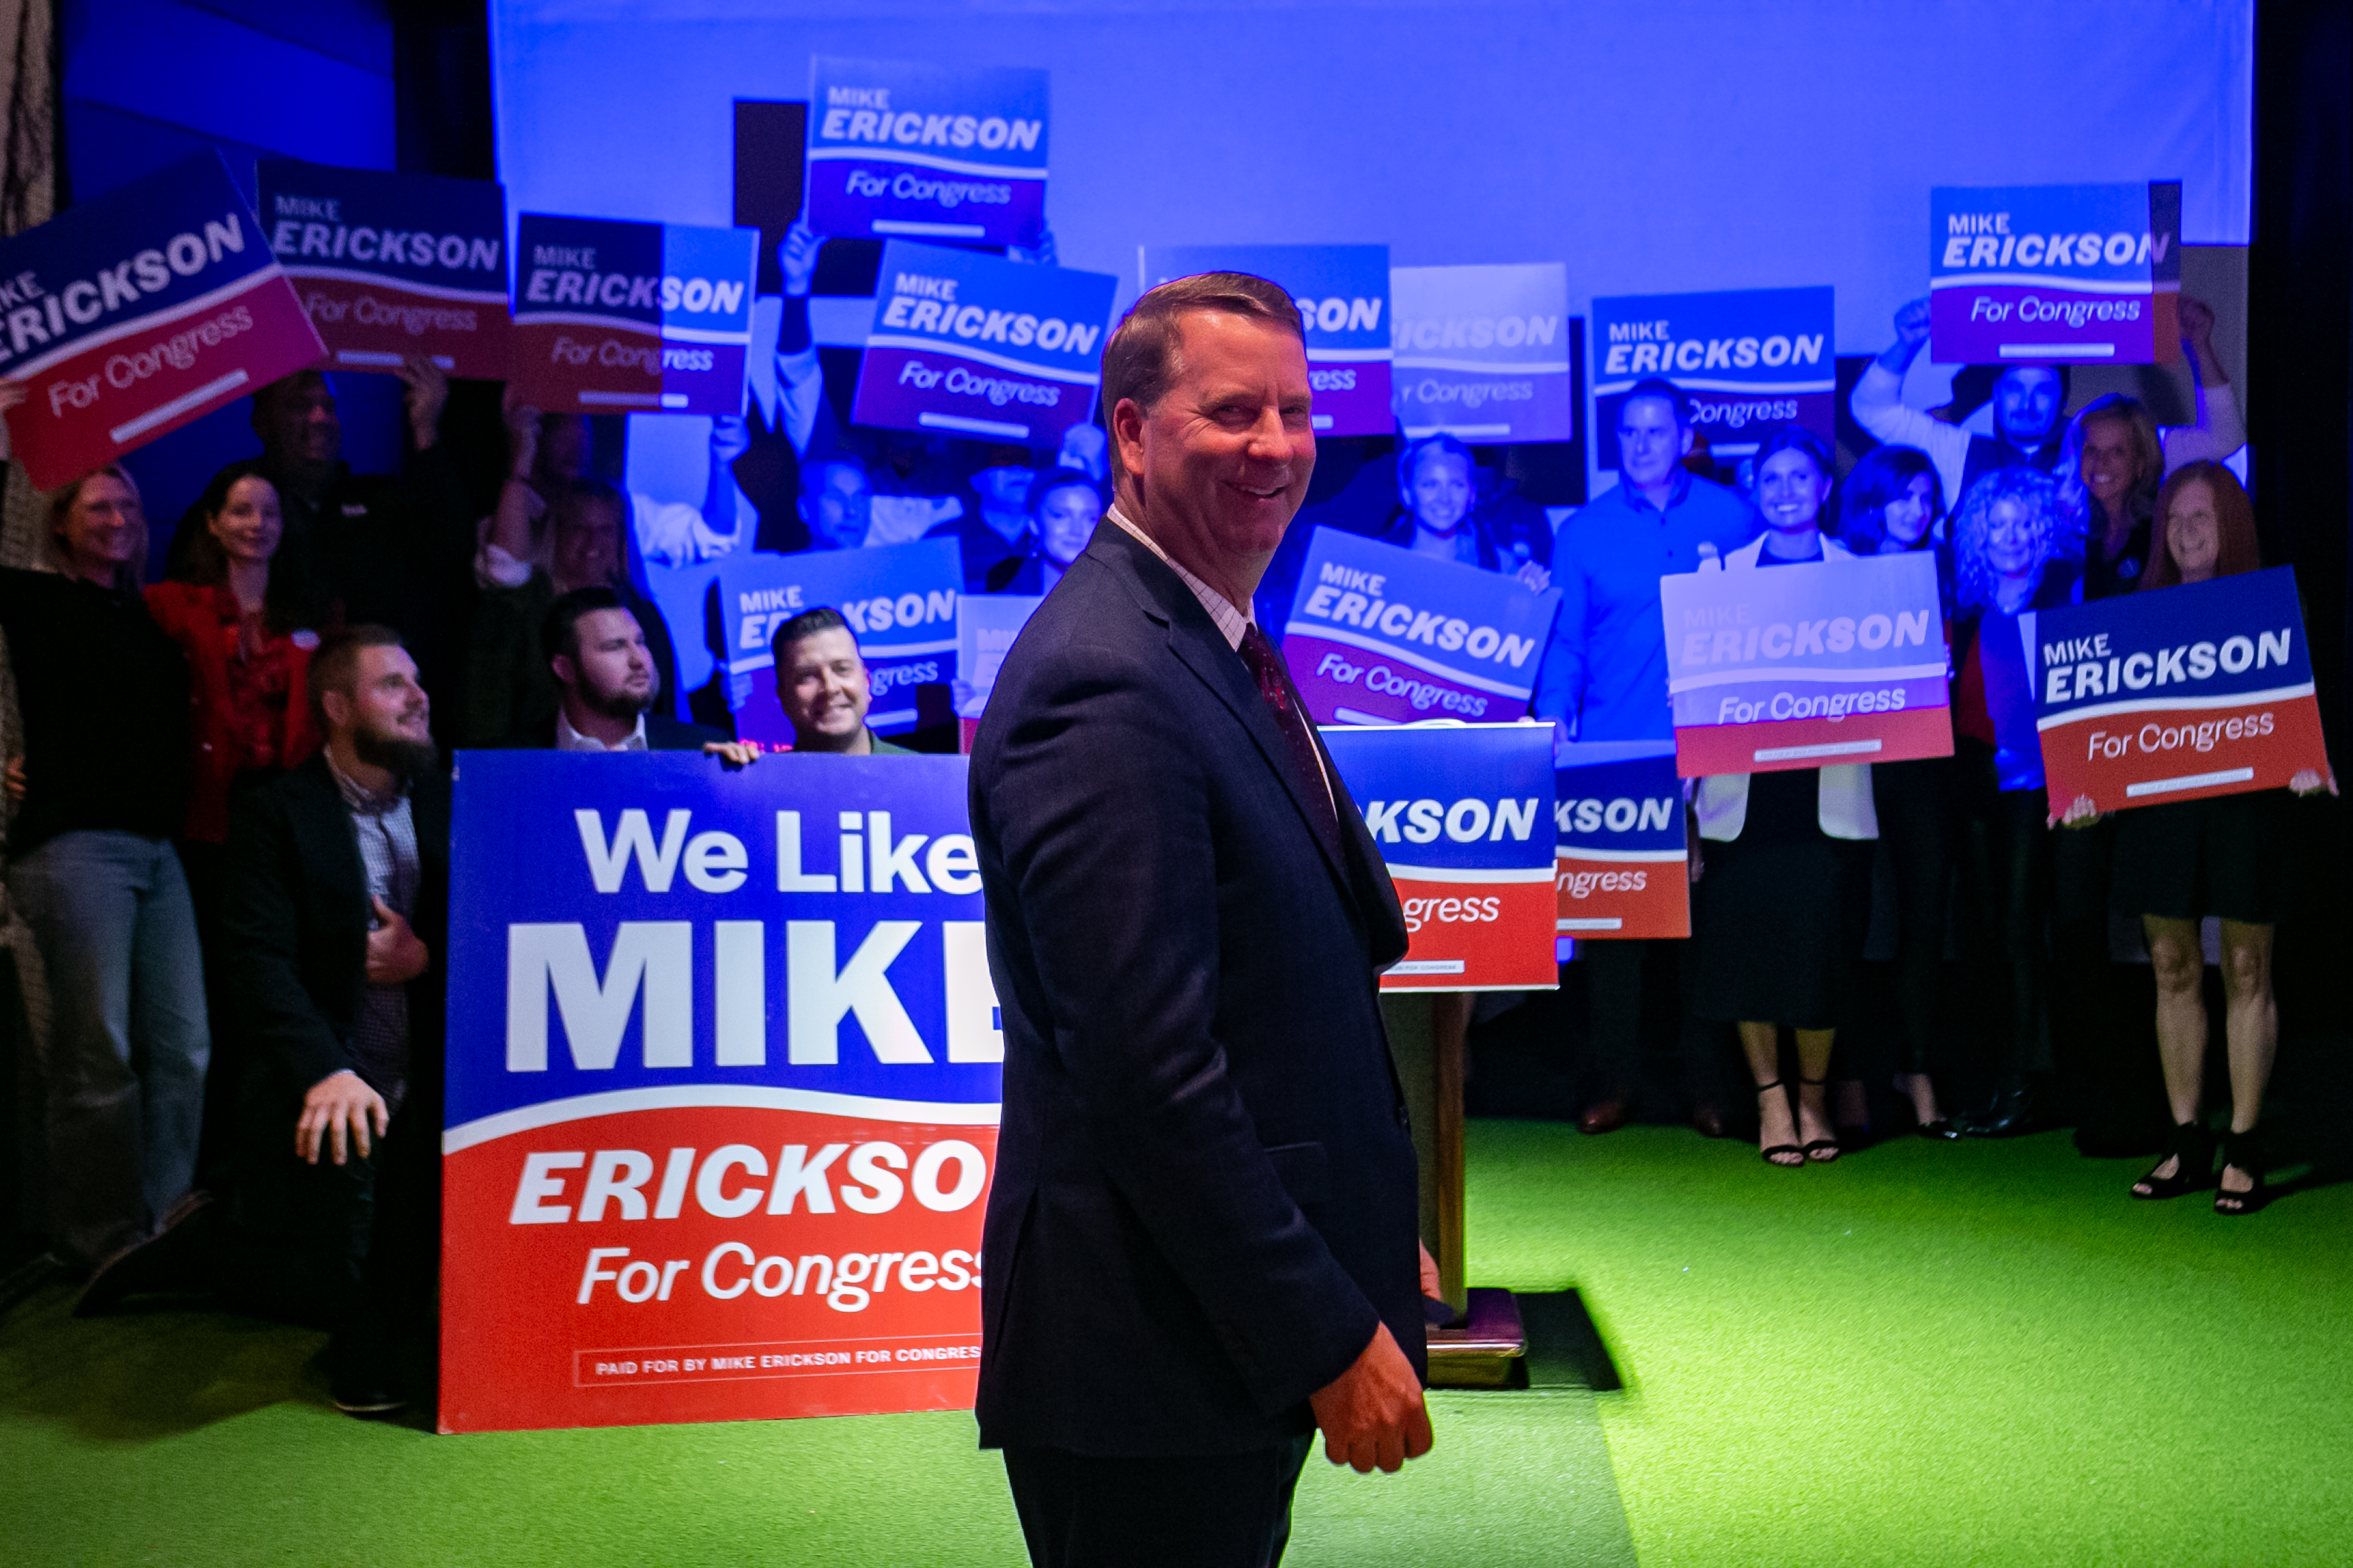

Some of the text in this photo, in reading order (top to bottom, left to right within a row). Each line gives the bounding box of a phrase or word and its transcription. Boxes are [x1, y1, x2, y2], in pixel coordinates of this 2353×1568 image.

[828, 86, 890, 110] MIKE
[821, 108, 1041, 151] ERICKSON
[274, 195, 340, 221] MIKE
[846, 170, 1012, 208] For Congress
[1949, 212, 2011, 235] MIKE
[272, 219, 500, 272] ERICKSON
[533, 245, 596, 269] MIKE
[1943, 233, 2171, 267] ERICKSON
[0, 270, 46, 309] KE
[526, 269, 744, 314] ERICKSON
[895, 272, 958, 302] MIKE
[306, 292, 477, 335] For Congress
[883, 296, 1100, 356] ERICKSON
[1609, 320, 1669, 341] MIKE
[1971, 295, 2141, 329] For Congress
[48, 305, 253, 418] For Congress
[552, 336, 714, 375] For Congress
[1605, 334, 1824, 374] ERICKSON
[898, 360, 1061, 408] For Congress
[1417, 378, 1533, 409] Congress
[1320, 562, 1386, 596] MIKE
[740, 585, 803, 614] MIKE
[1684, 605, 1749, 628] MIKE
[1305, 585, 1535, 667] ERICKSON
[1681, 610, 1929, 665] ERICKSON
[2043, 633, 2112, 667] MIKE
[2046, 628, 2290, 704] ERICKSON
[1316, 653, 1488, 717] For Congress
[1718, 688, 1905, 725] For Congress
[2088, 712, 2274, 761] For Congress
[575, 809, 984, 895] We Like
[577, 1247, 688, 1305] For
[596, 1361, 638, 1375] PAID
[642, 1359, 678, 1373] FOR
[683, 1358, 707, 1372] BY
[711, 1355, 756, 1370] MIKE
[760, 1352, 850, 1368] ERICKSON
[855, 1350, 891, 1364] FOR
